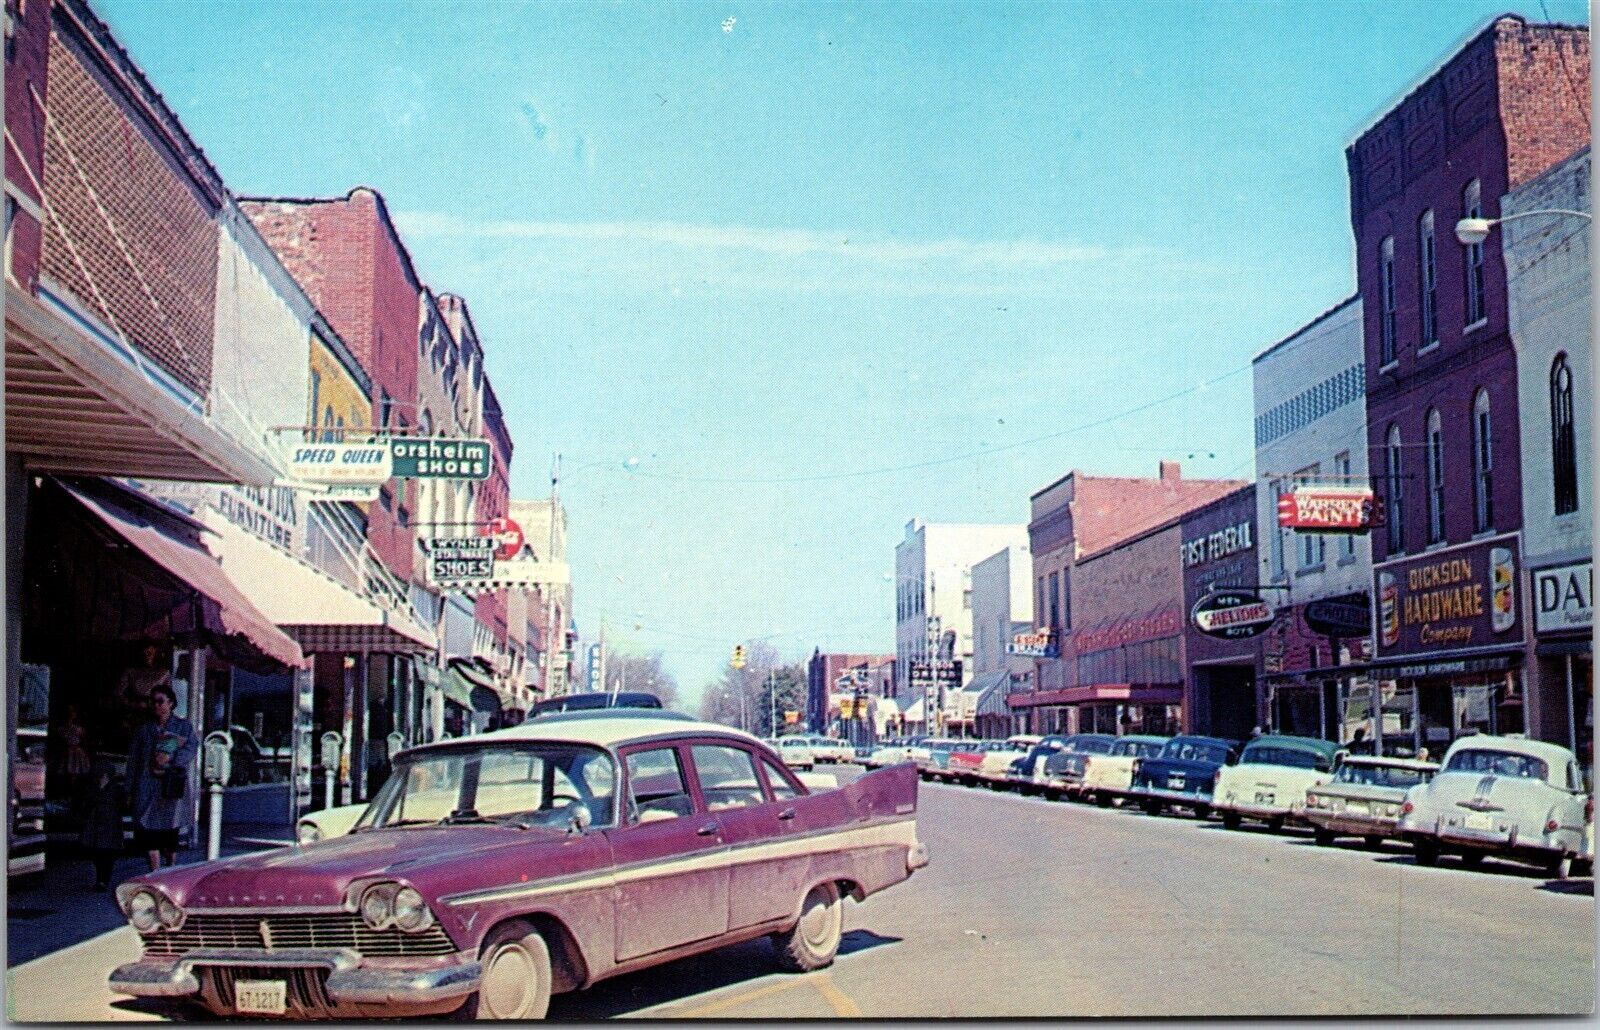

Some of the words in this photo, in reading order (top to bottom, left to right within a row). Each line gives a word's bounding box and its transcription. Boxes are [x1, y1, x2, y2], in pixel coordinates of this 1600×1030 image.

[293, 449, 336, 463] SPEED
[342, 450, 384, 464] QUEEN
[394, 440, 483, 459] orsheim
[417, 461, 484, 474] SHOES
[220, 490, 292, 549] FURNITURE
[434, 560, 489, 576] SHOES
[1408, 558, 1472, 592] DICKSON
[1540, 568, 1593, 613] DA
[1404, 583, 1484, 626] HARDWARE
[1420, 623, 1473, 645] Company
